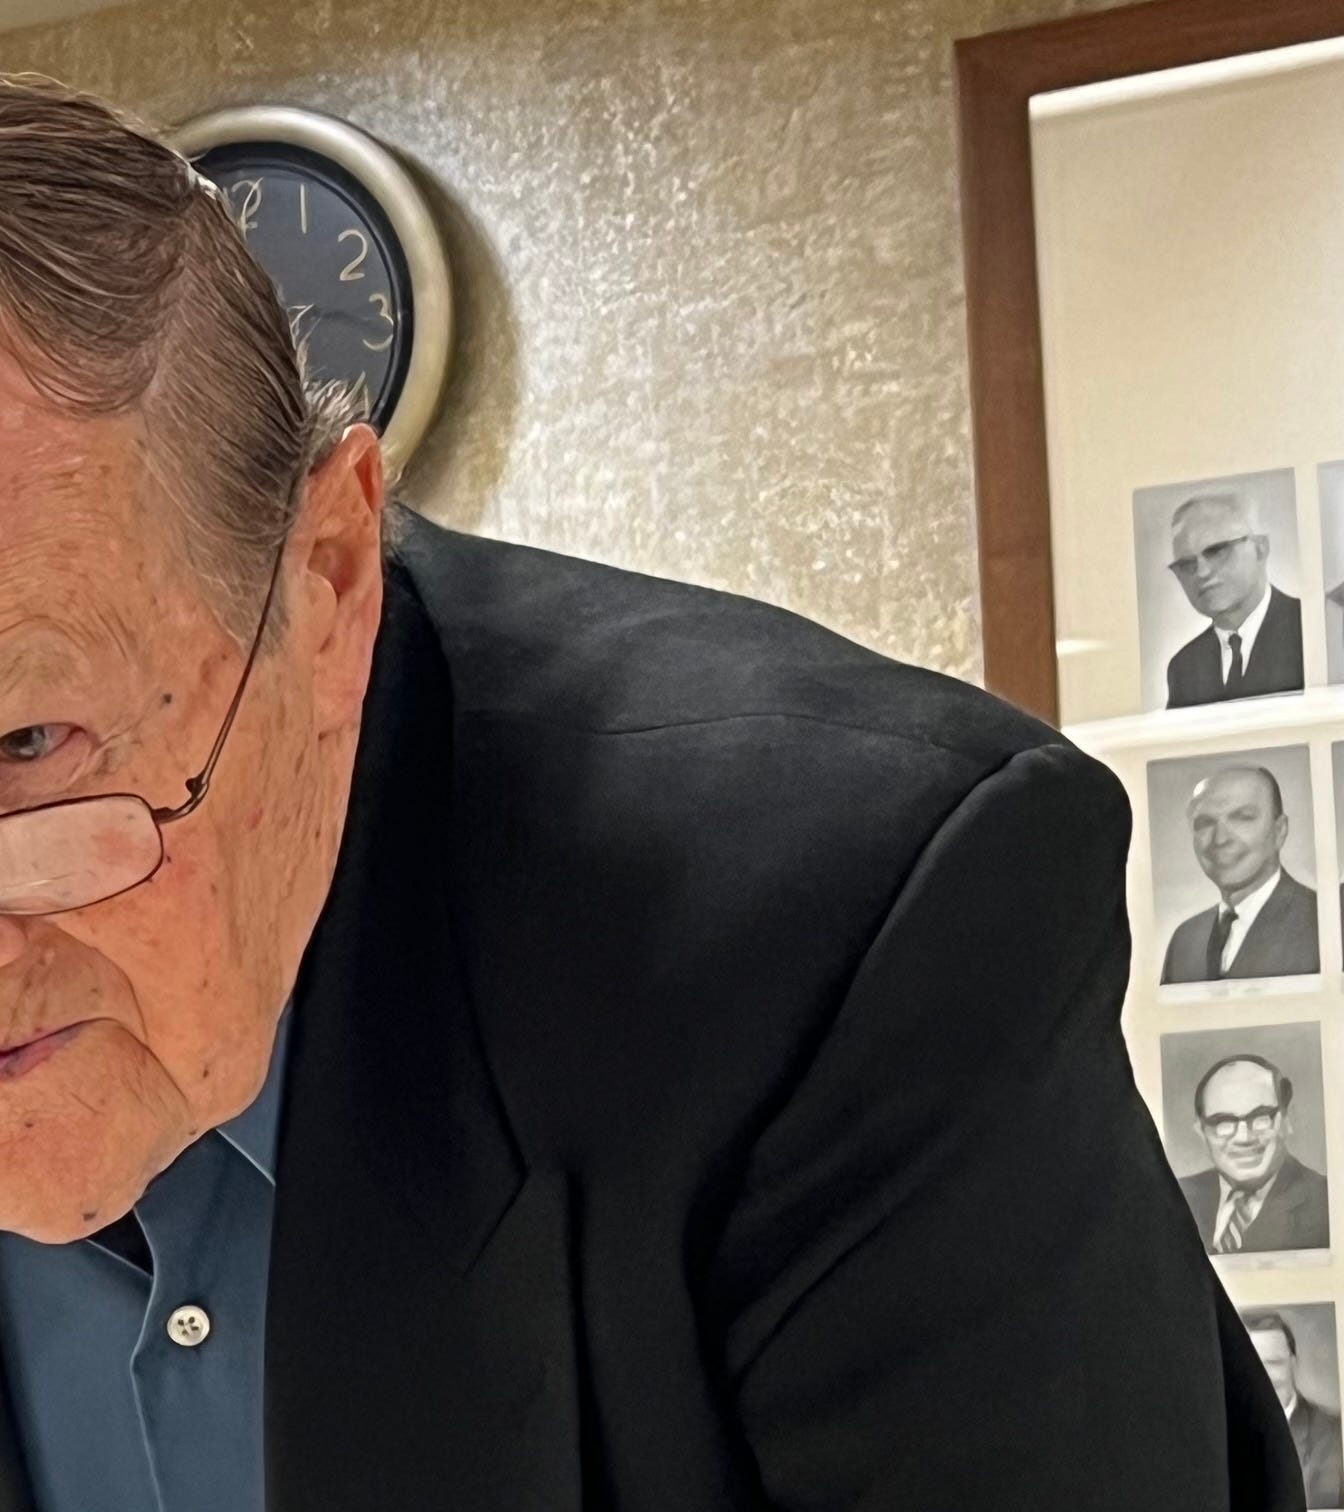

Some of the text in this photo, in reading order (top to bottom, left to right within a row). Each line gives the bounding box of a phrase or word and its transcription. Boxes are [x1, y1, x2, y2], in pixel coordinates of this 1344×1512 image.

[222, 180, 261, 230] 2
[337, 229, 367, 281] 2
[362, 293, 394, 351] 3
